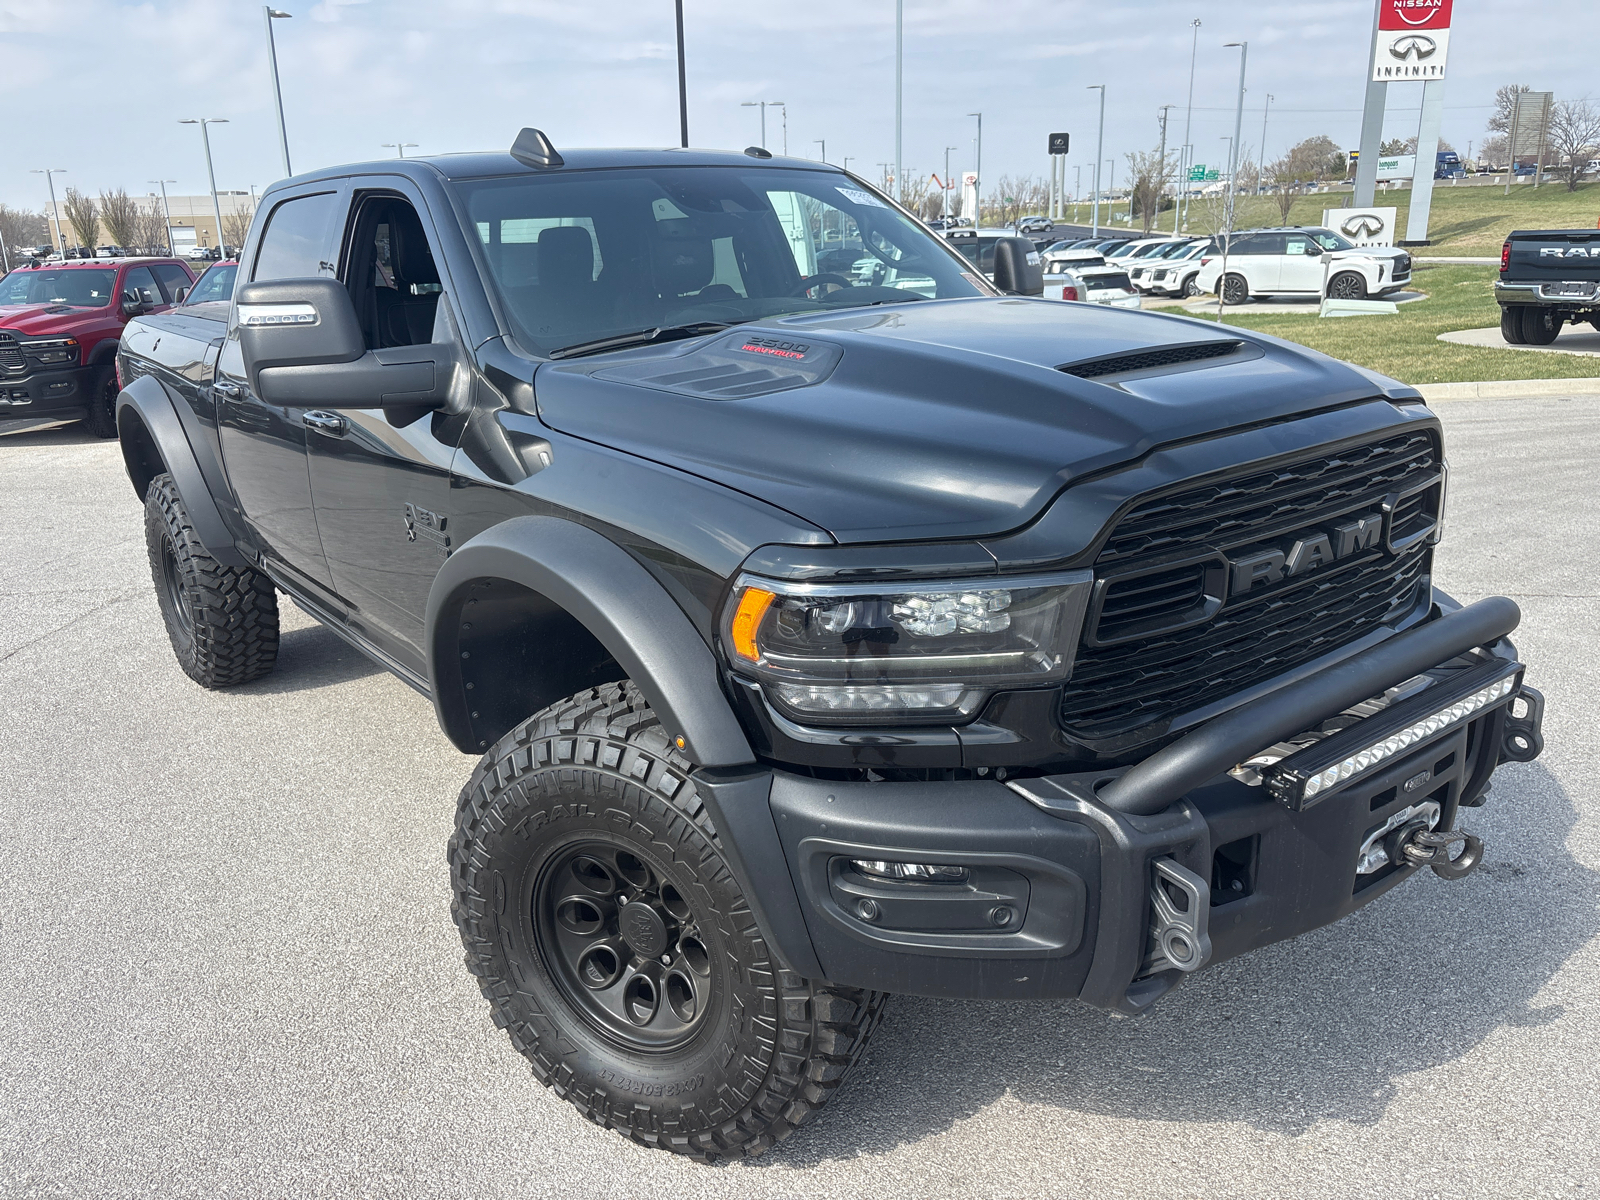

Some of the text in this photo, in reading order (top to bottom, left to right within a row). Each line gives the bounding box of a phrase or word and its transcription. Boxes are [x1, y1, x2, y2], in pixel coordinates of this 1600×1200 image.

[1393, 0, 1442, 8] NISSAN
[1377, 65, 1444, 77] INFINITI
[746, 337, 811, 354] 2500
[1231, 512, 1383, 596] RAM
[512, 803, 597, 840] TRAIL
